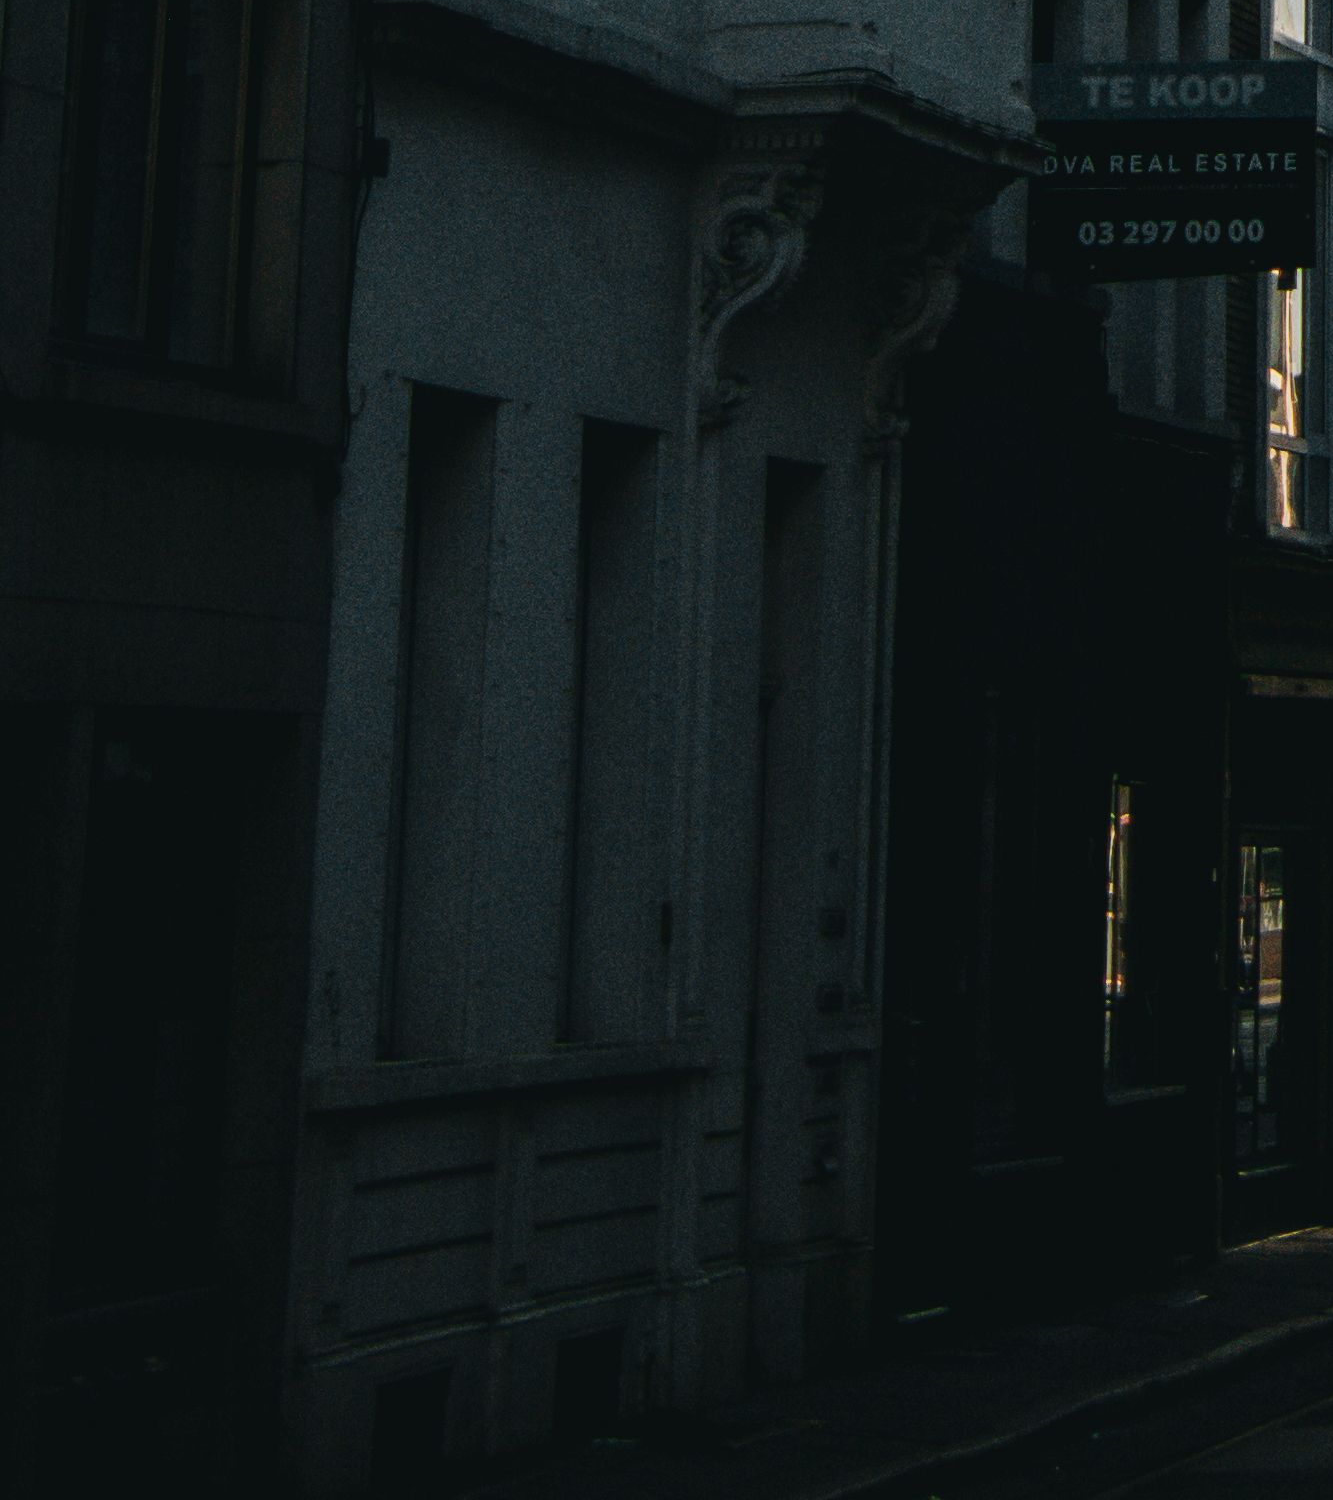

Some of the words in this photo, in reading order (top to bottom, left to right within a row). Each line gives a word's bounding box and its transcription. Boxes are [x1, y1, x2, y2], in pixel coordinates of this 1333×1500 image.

[1081, 75, 1135, 109] TE
[1147, 73, 1267, 109] KOOP
[1044, 155, 1096, 175] DVA
[1110, 153, 1182, 174] REAL
[1195, 152, 1298, 173] ESTATE
[1077, 221, 1114, 246] 03
[1122, 220, 1178, 245] 297
[1184, 219, 1222, 245] 00
[1228, 219, 1266, 244] 00
